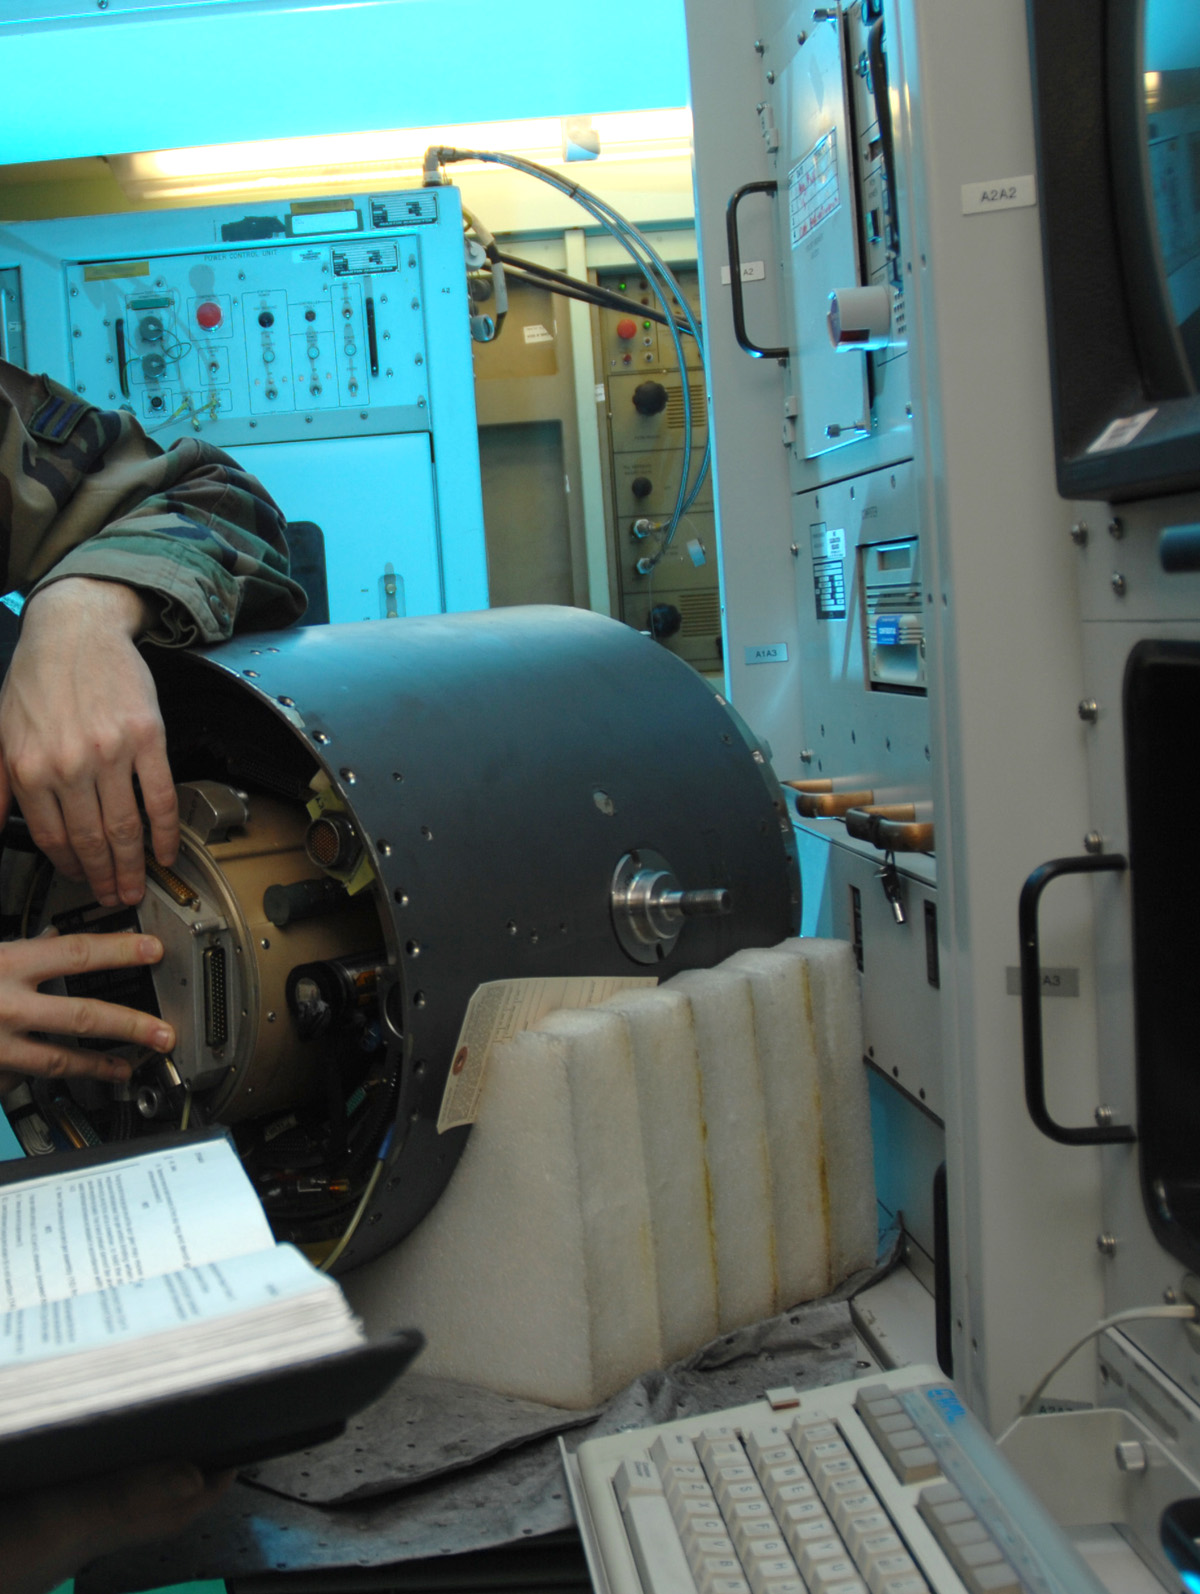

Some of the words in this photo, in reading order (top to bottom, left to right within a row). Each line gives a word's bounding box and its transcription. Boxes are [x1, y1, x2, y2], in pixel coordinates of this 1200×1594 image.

[979, 187, 1017, 203] A2A2
[229, 250, 258, 260] CONTROL
[262, 248, 279, 257] UNIT
[754, 649, 778, 659] A1A3
